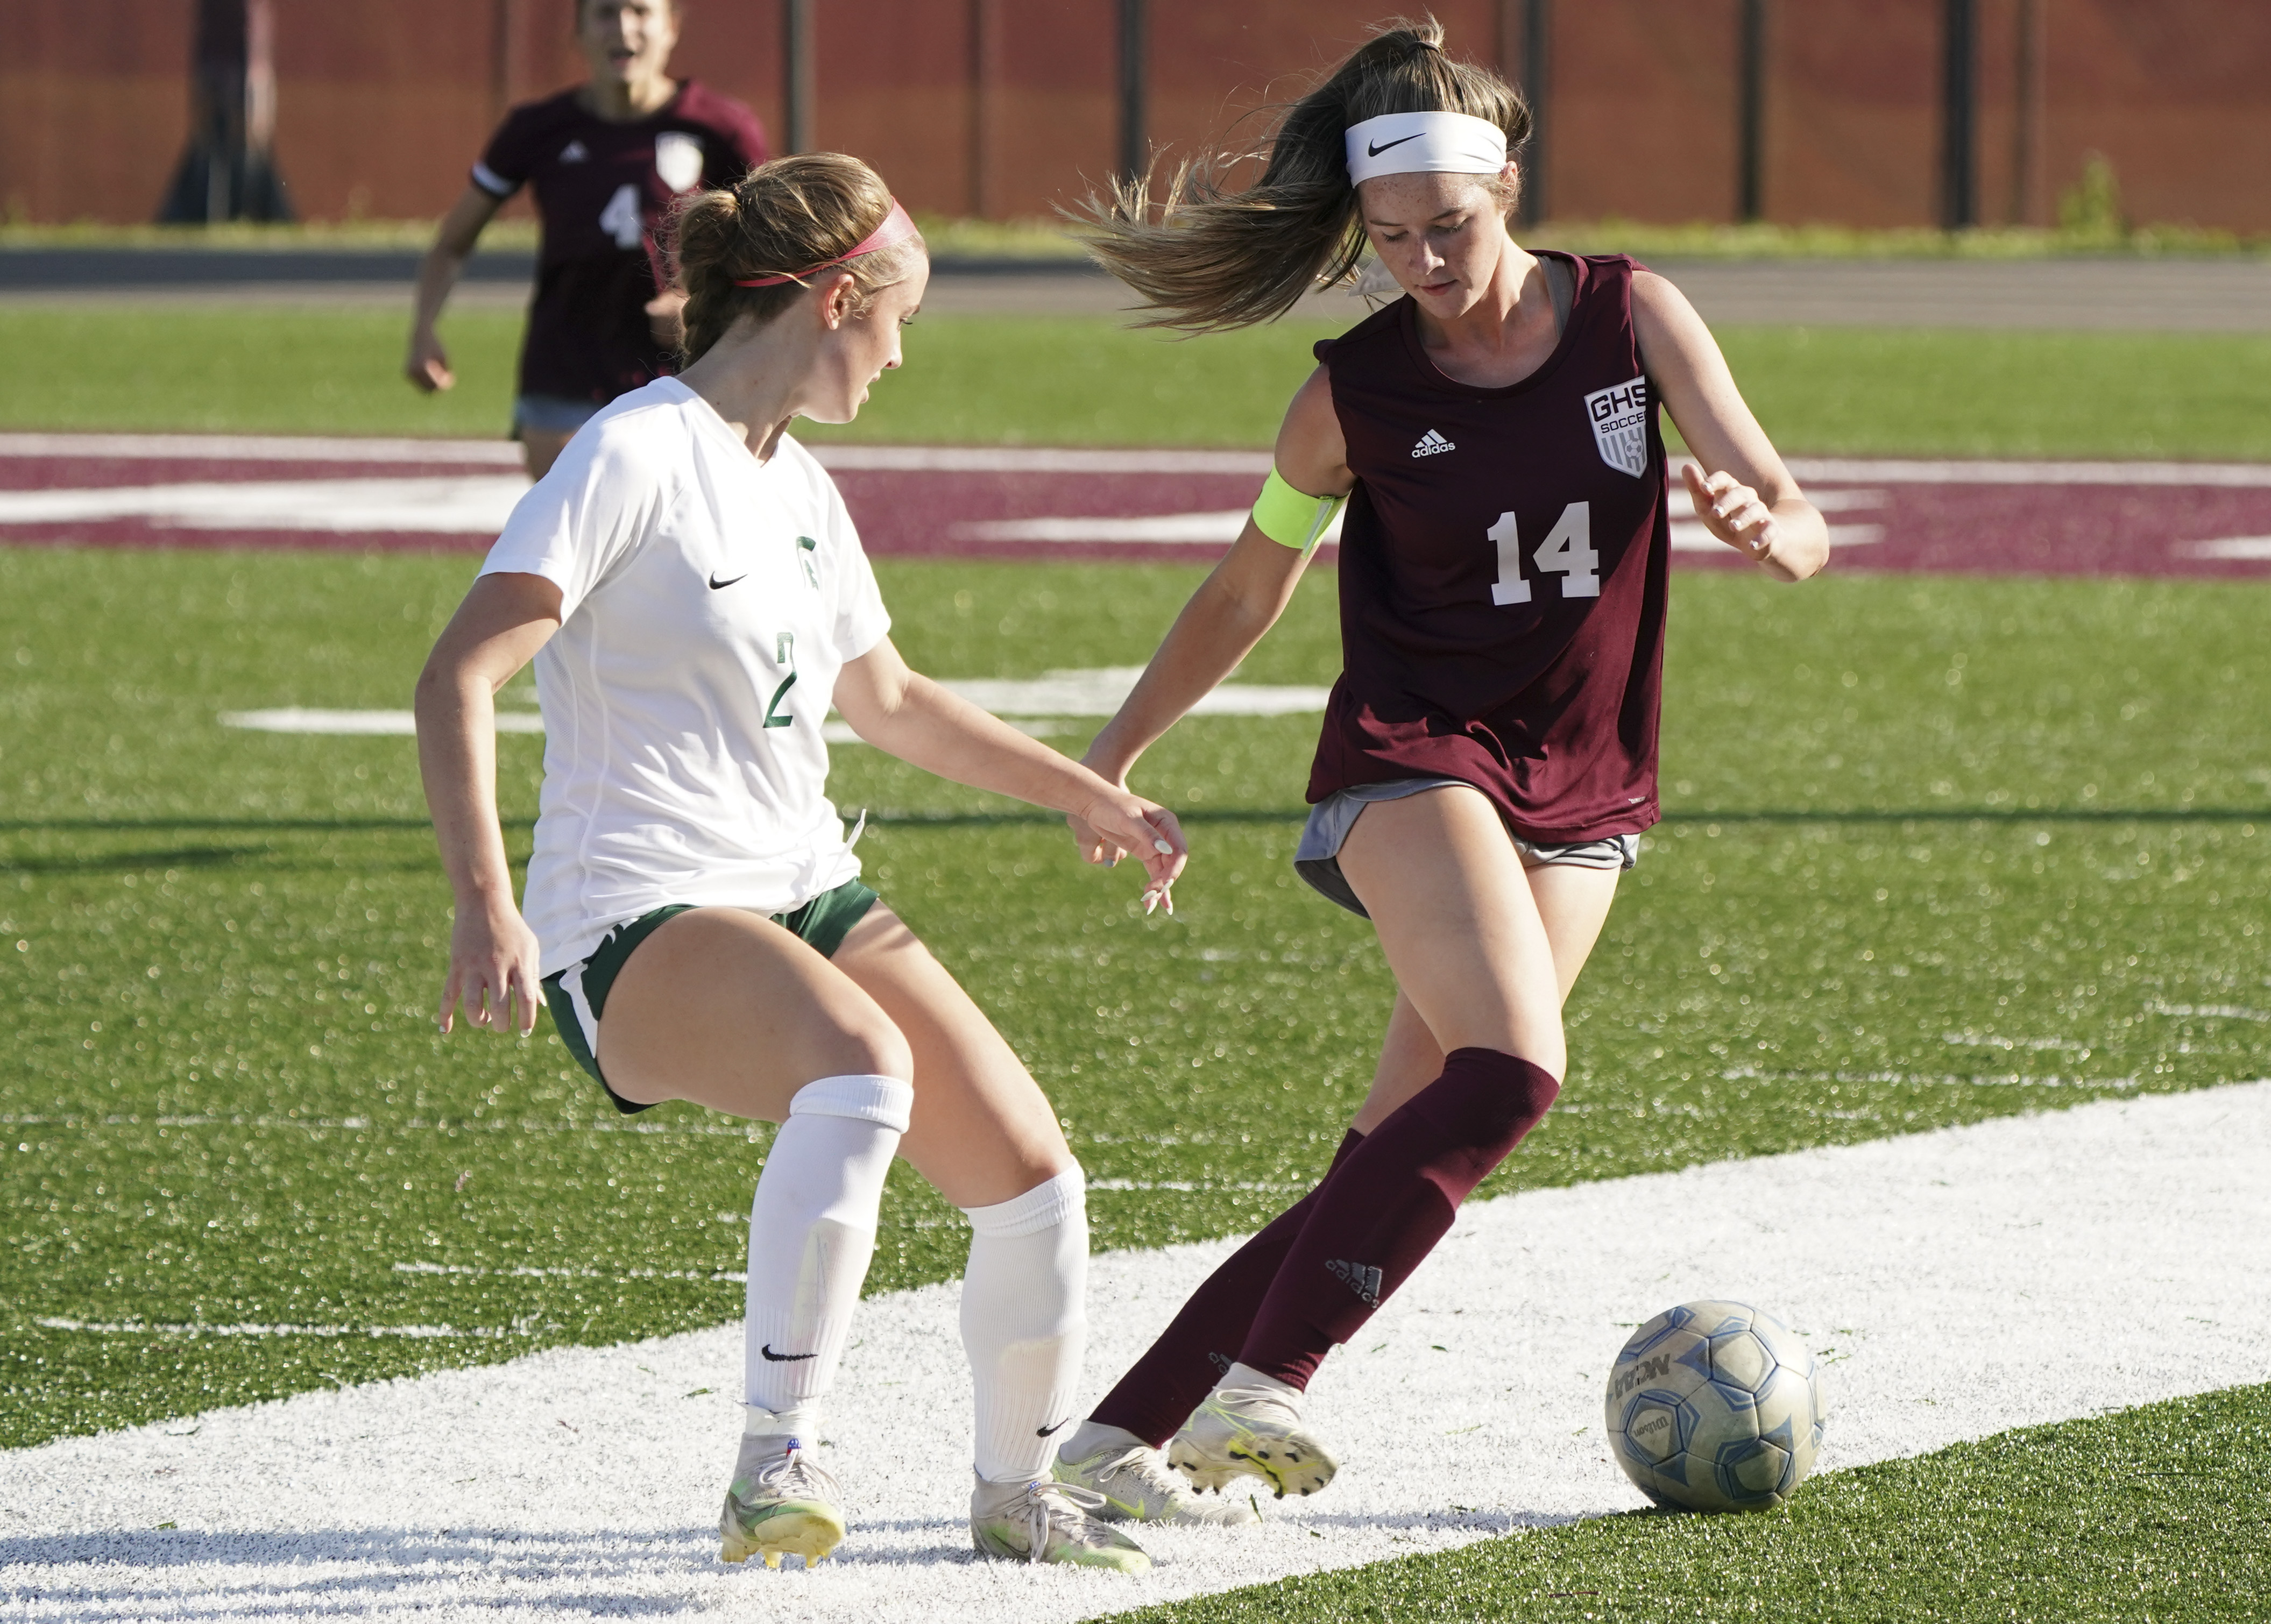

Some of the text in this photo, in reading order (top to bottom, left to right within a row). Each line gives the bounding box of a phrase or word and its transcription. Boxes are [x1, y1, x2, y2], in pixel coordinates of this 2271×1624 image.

[599, 183, 643, 250] 4
[1590, 384, 1646, 422] GHS
[1601, 411, 1646, 434] SOCCE
[1411, 442, 1455, 458] adidas
[1487, 501, 1600, 606] 14
[762, 632, 797, 728] 2
[1325, 1260, 1379, 1309] adidas
[1615, 1353, 1670, 1400] NCAA
[1633, 1415, 1669, 1438] Wilson
